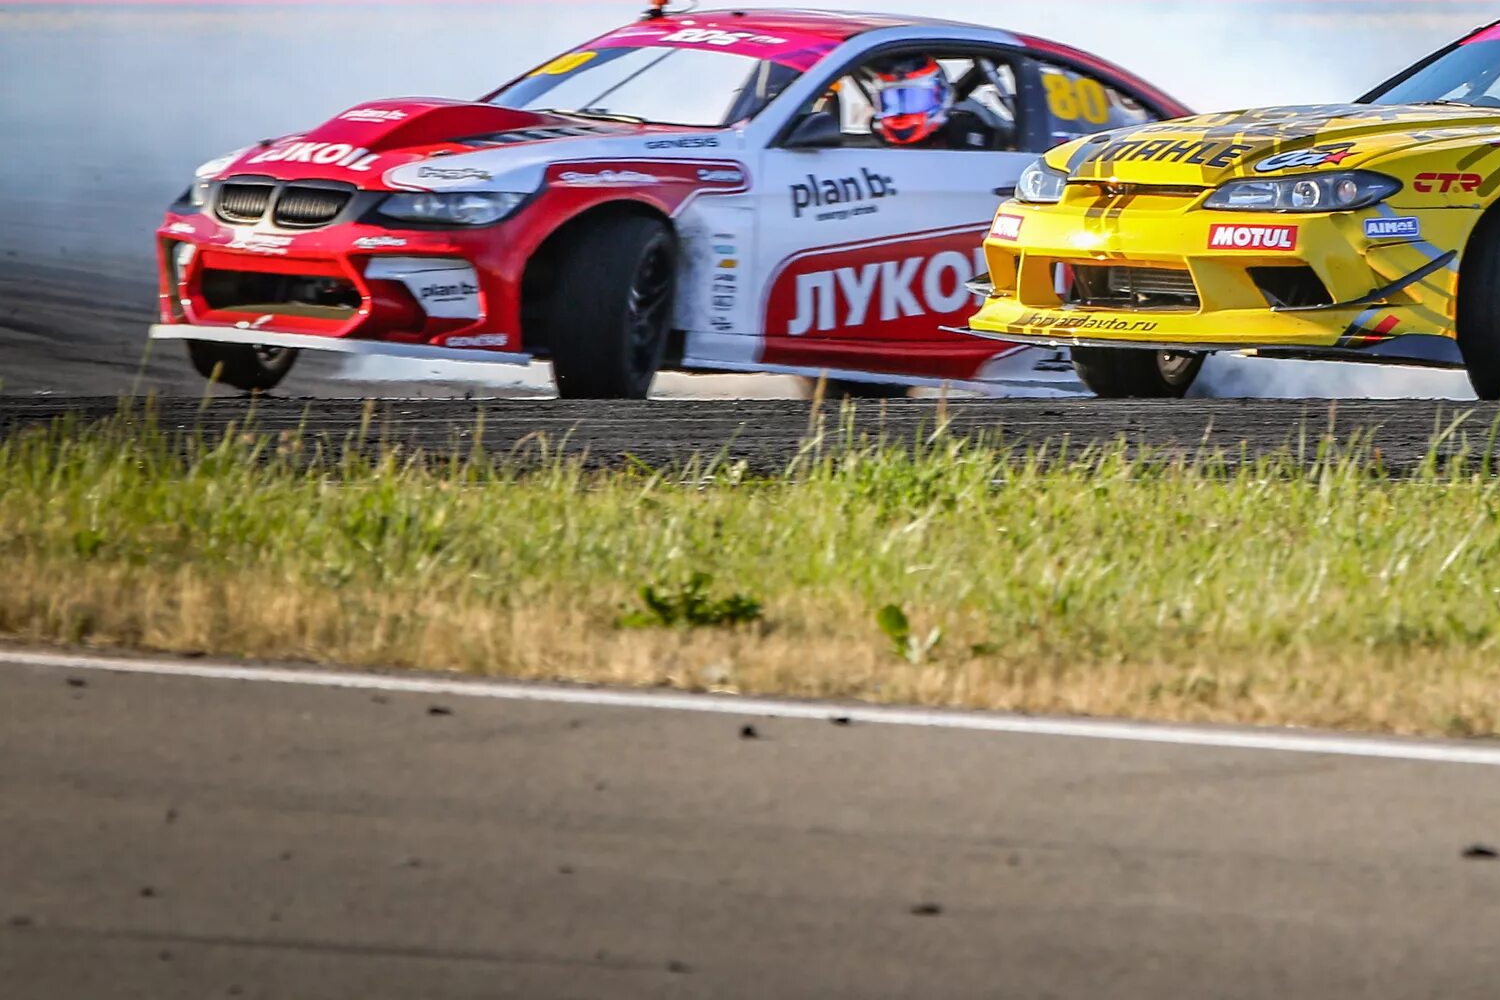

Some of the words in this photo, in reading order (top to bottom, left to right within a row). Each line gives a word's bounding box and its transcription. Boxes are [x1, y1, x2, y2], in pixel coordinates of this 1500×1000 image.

[1041, 73, 1109, 124] 80
[644, 137, 720, 149] GENESIS
[1088, 138, 1256, 169] MAHLE
[1413, 172, 1483, 193] CTR
[789, 173, 863, 218] plan
[1211, 225, 1292, 248] MOTUL
[1366, 221, 1417, 235] AIMOL
